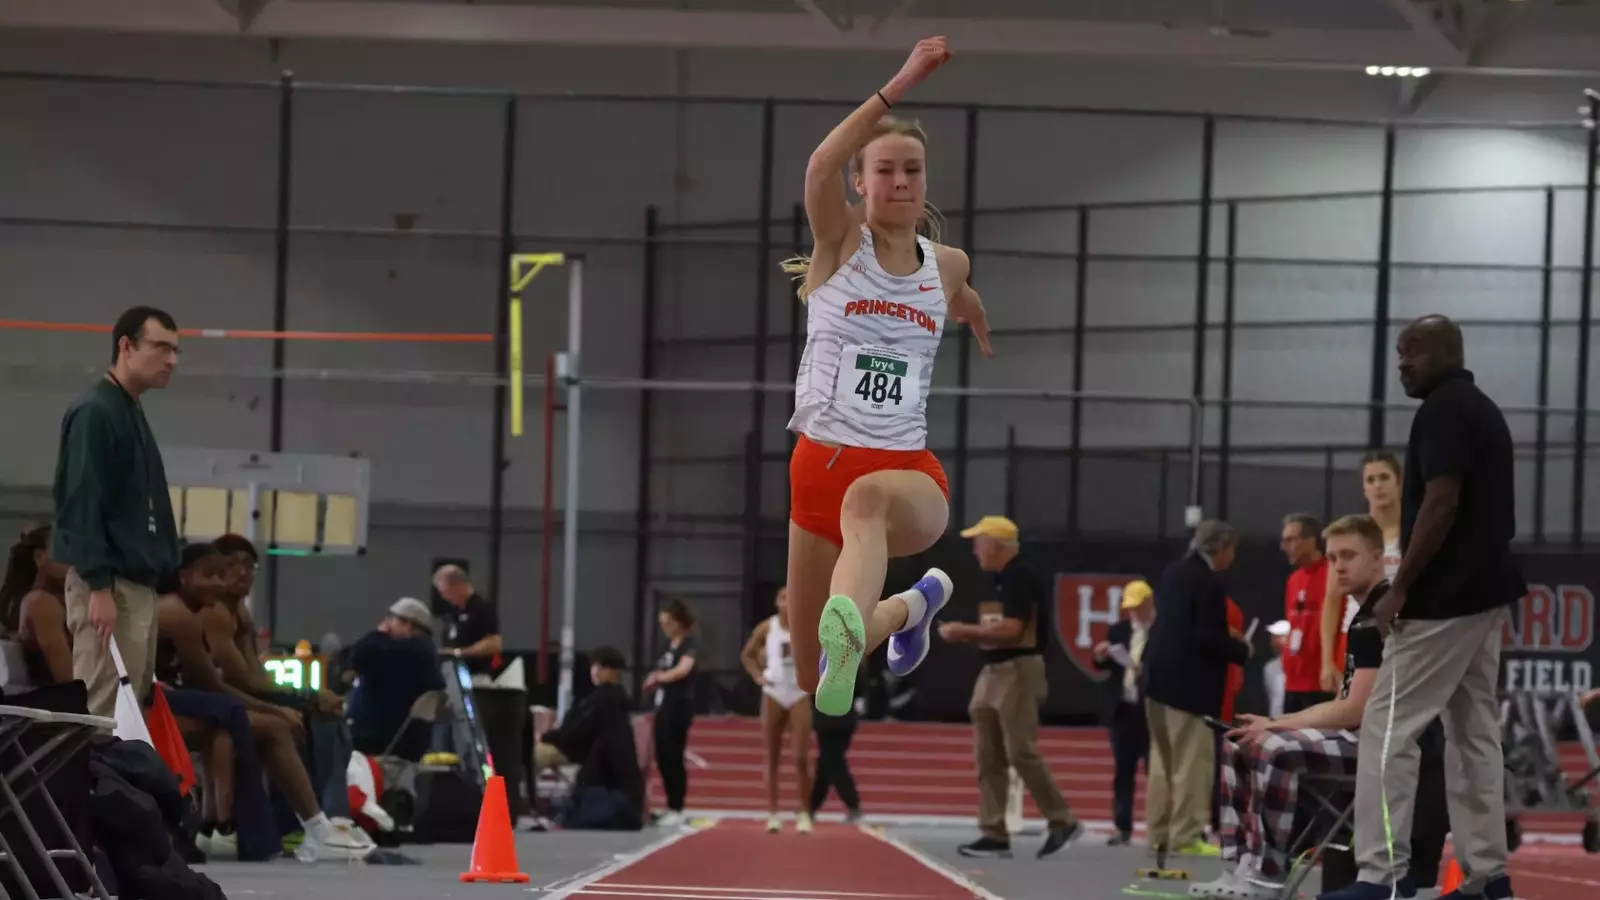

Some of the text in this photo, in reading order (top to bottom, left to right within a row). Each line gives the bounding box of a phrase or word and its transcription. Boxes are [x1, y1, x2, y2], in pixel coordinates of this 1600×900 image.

[844, 300, 936, 336] PRINCETON
[870, 358, 888, 371] Ivy
[855, 371, 902, 405] 484
[1075, 585, 1122, 648] H
[1505, 659, 1592, 693] FIELD
